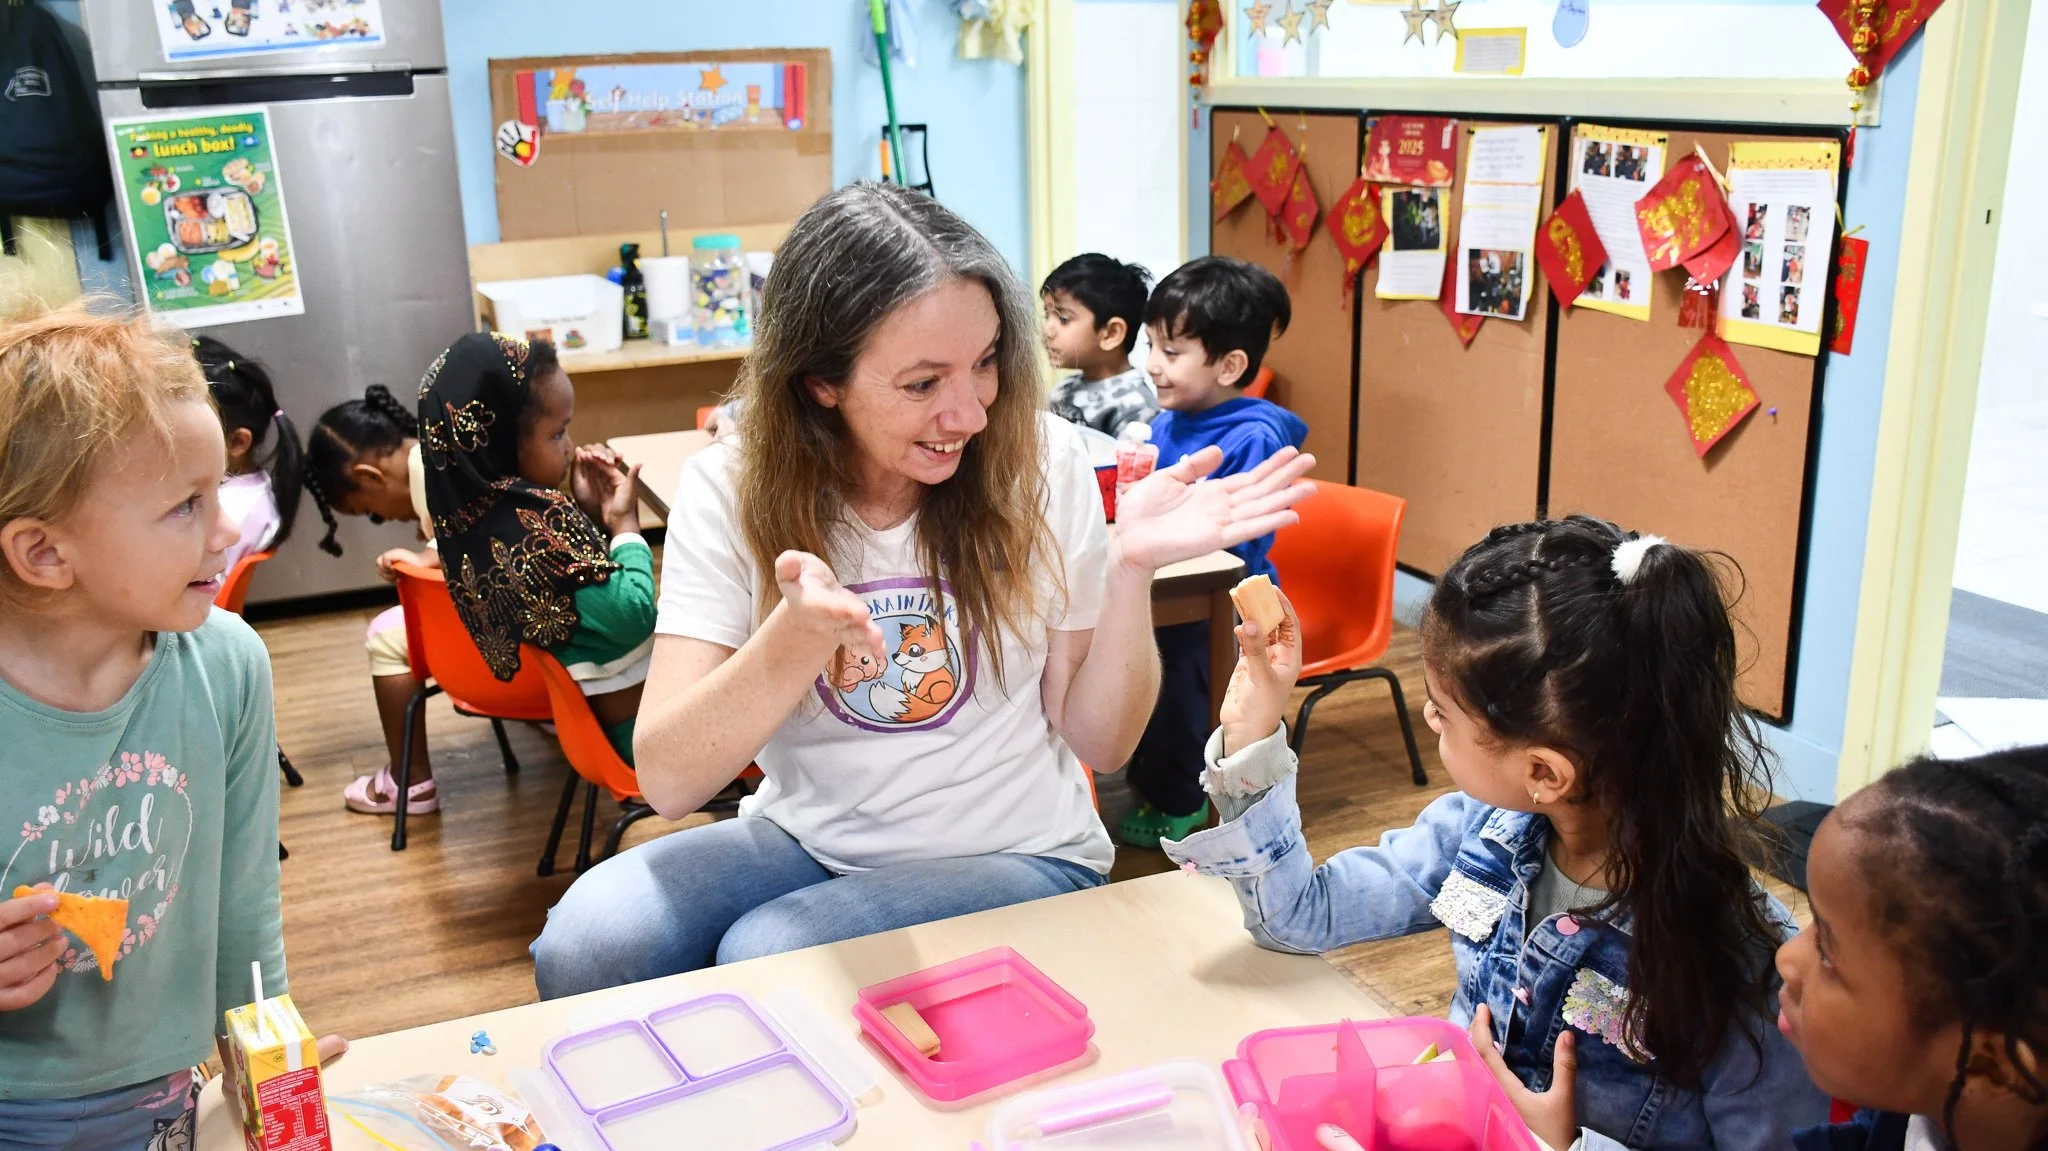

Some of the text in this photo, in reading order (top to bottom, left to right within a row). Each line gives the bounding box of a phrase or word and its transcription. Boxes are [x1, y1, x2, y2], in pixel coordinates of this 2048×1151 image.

[629, 90, 670, 111] Help
[677, 89, 743, 107] Station
[130, 131, 169, 142] Pking
[169, 130, 177, 139] a
[221, 123, 253, 135] deadly
[201, 135, 235, 154] box!
[1398, 138, 1425, 157] 2025
[917, 593, 960, 627] TAK
